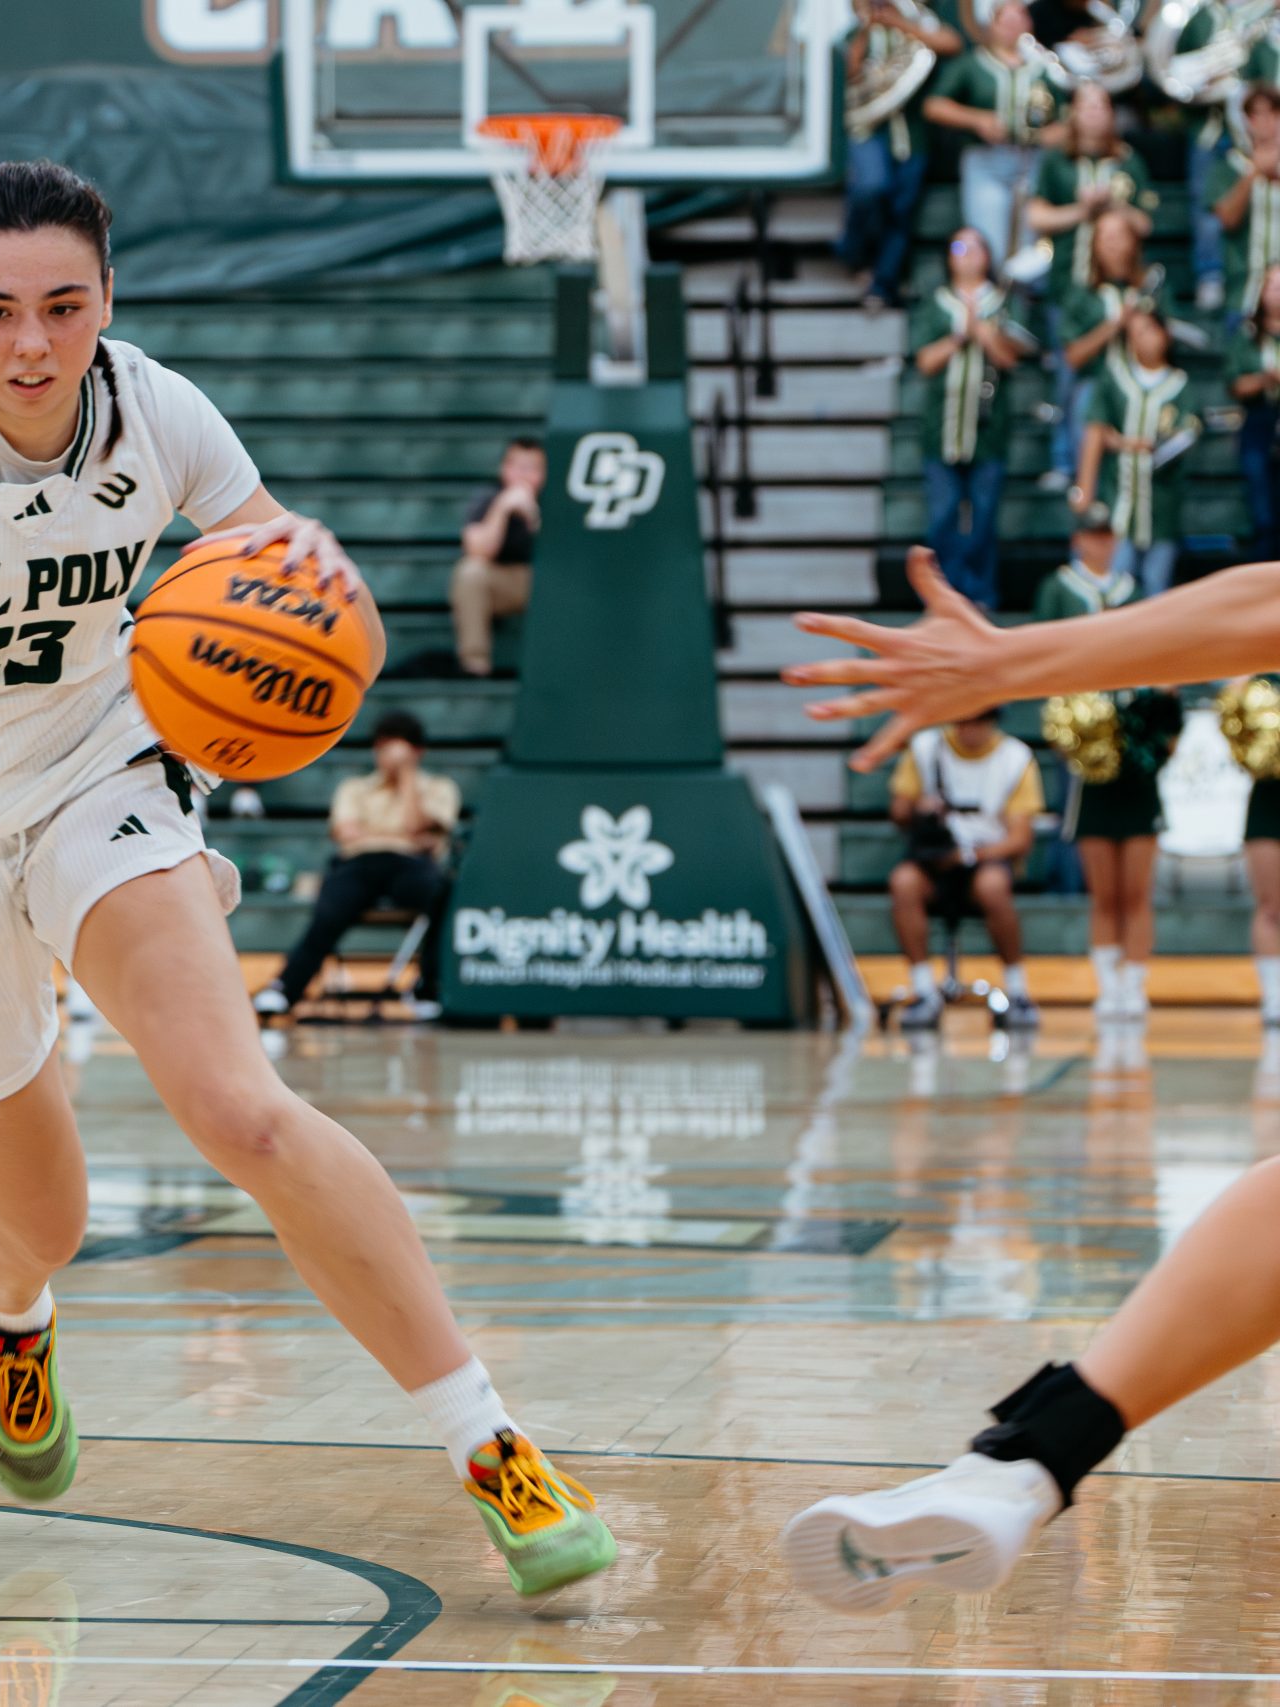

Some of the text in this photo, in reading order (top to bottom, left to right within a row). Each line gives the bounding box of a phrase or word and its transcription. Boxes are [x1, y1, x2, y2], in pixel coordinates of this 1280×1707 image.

[21, 540, 146, 612] POLY
[224, 574, 340, 635] NCAA
[191, 634, 335, 718] Wilson
[453, 906, 767, 967] Dignity Health
